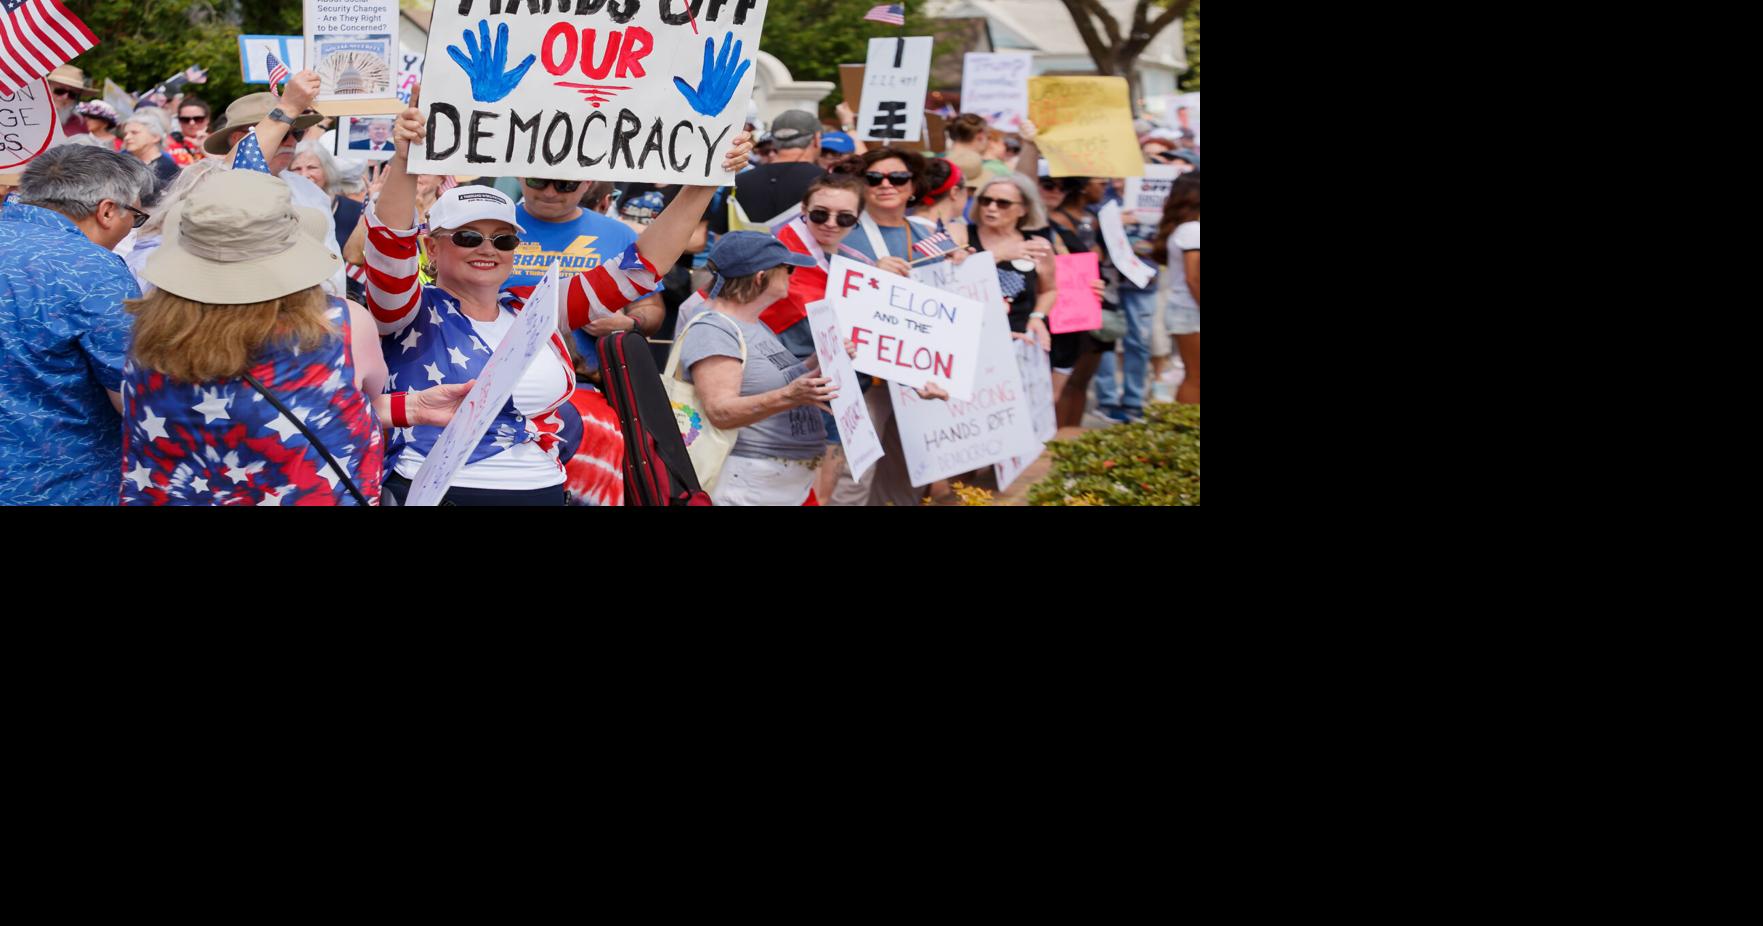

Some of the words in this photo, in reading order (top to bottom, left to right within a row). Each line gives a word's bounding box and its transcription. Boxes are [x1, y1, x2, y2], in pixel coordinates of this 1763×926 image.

[317, 5, 351, 13] Security
[353, 5, 387, 13] Changes
[339, 14, 359, 23] They
[361, 14, 381, 23] Right
[540, 21, 654, 80] OUR
[426, 102, 732, 178] DEMOCRACY
[873, 310, 899, 326] AND
[905, 318, 933, 334] THE
[889, 285, 957, 324] ELON
[850, 326, 954, 380] FELON
[923, 419, 981, 452] HANDS
[987, 406, 1016, 431] OFF
